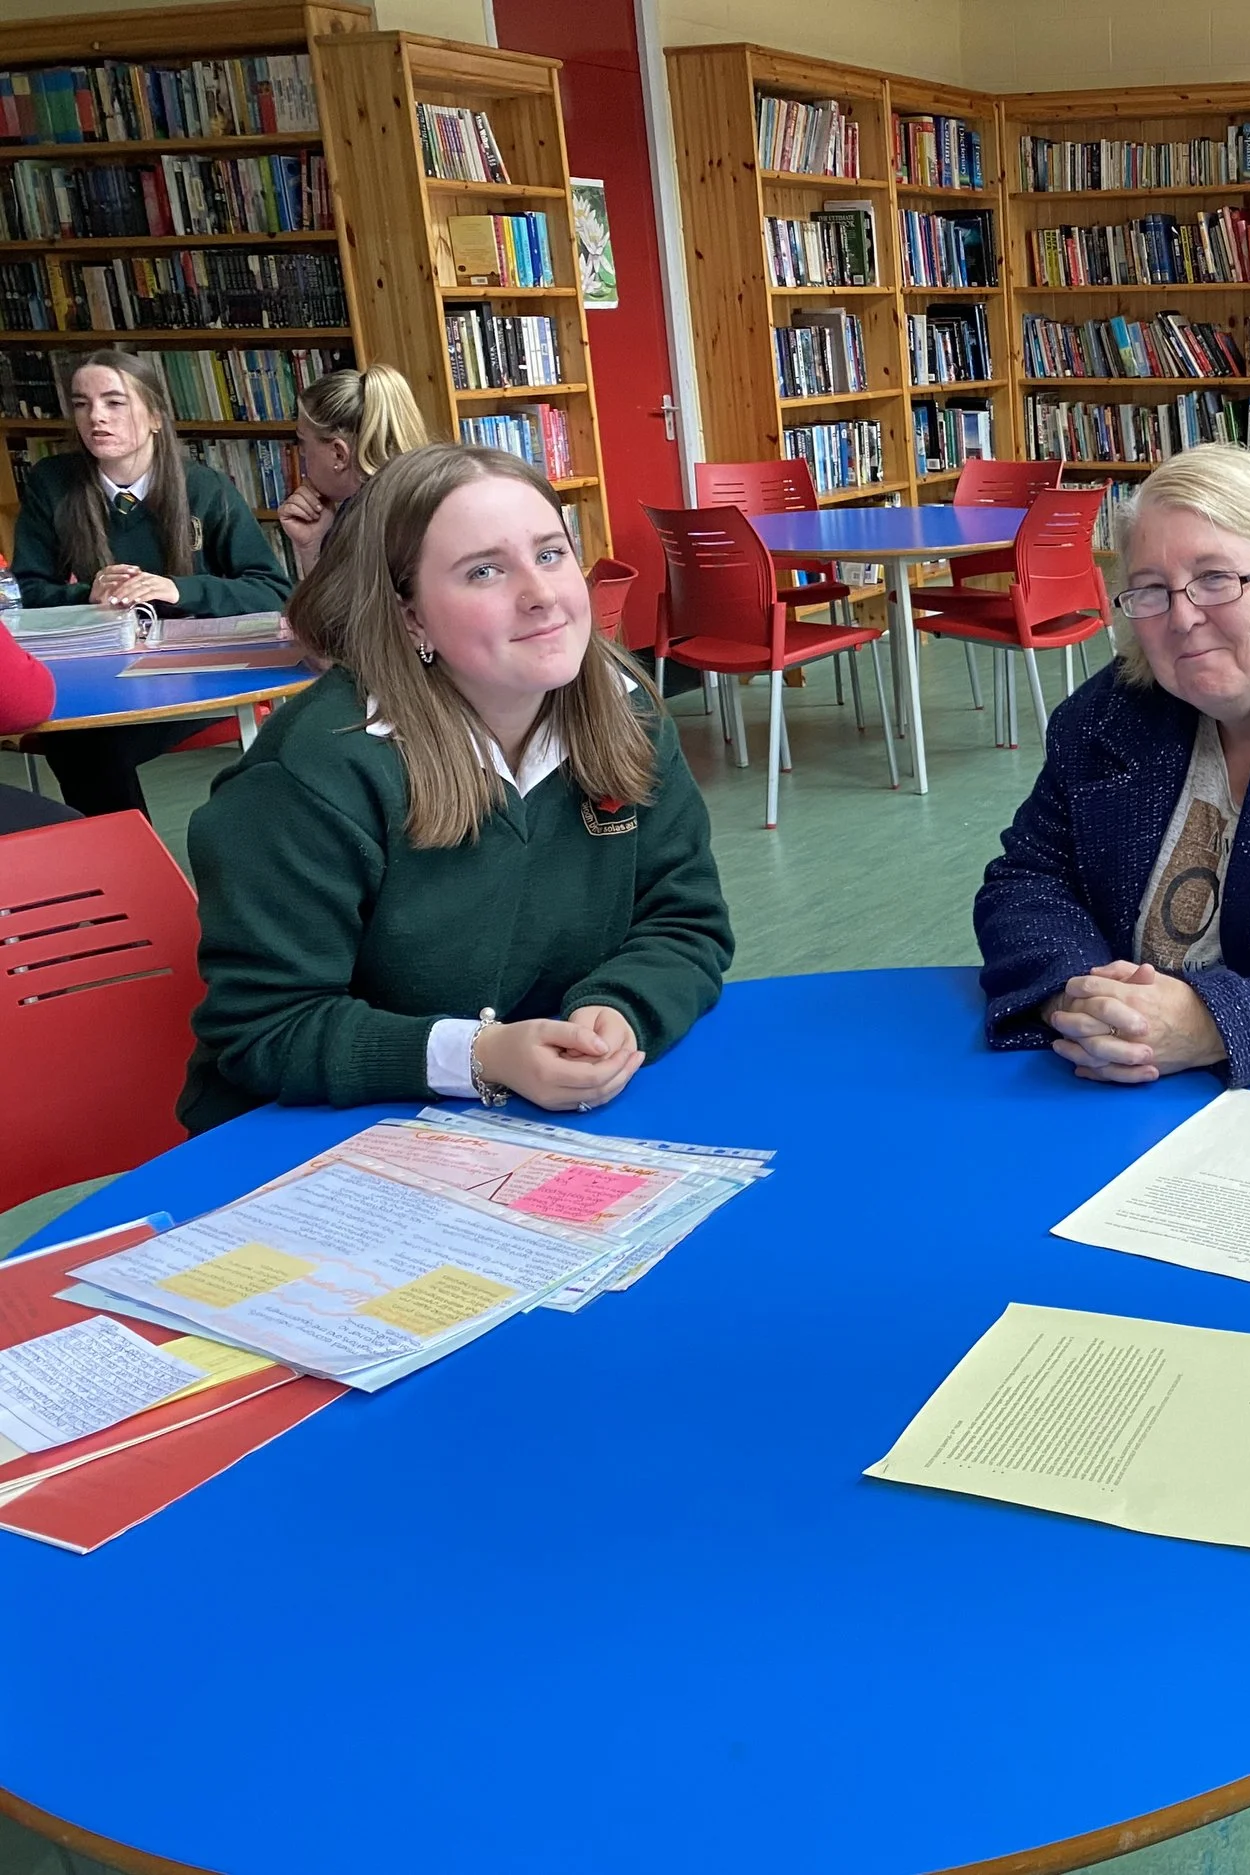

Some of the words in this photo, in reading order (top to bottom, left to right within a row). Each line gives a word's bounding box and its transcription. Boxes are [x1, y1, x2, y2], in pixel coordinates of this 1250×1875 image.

[959, 128, 967, 176] Dictionary
[603, 823, 626, 833] solas
[415, 1131, 489, 1148] Cellulose
